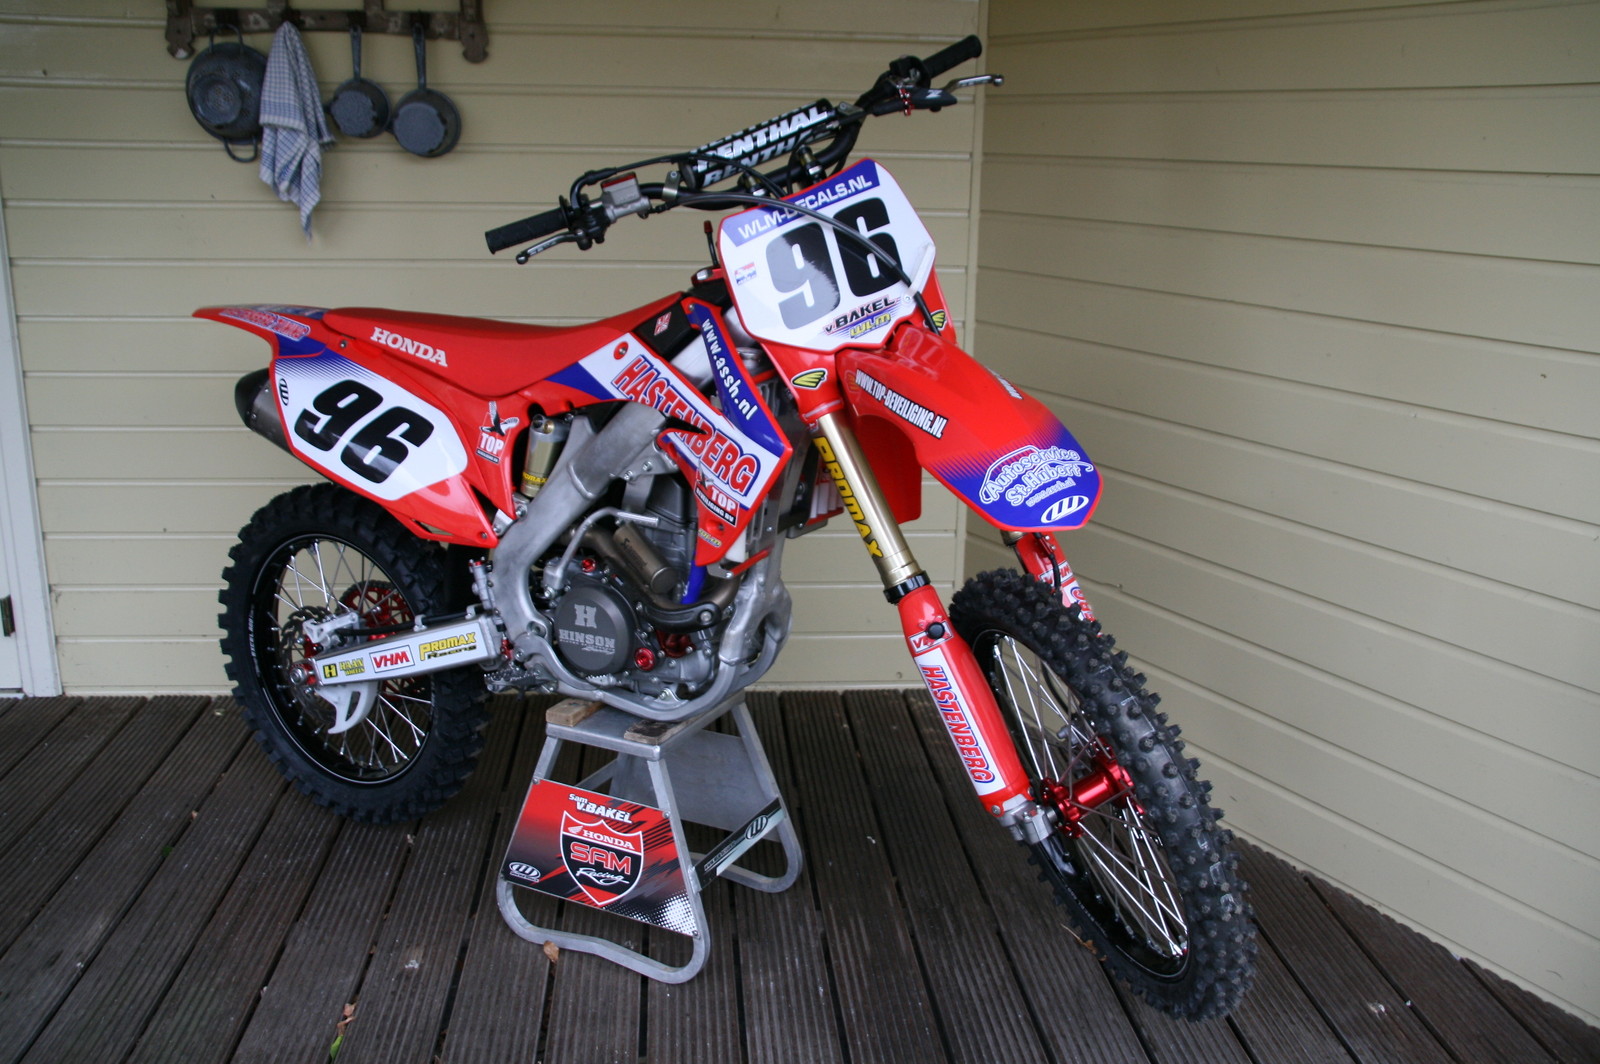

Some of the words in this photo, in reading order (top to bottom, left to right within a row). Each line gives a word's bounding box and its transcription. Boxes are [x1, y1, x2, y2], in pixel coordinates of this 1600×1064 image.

[738, 174, 872, 240] WLM-DECALS.NL
[765, 197, 901, 330] 96
[370, 327, 448, 368] HONDA
[702, 318, 758, 420] www.assh.nl
[294, 379, 435, 484] 96
[611, 354, 761, 497] HASTENBERG
[480, 432, 505, 455] TOP
[984, 445, 1081, 502] Autoservice
[711, 486, 737, 513] TOP
[812, 436, 884, 559] PROMAX
[574, 604, 597, 629] H
[419, 632, 477, 662] PROMAX
[558, 628, 616, 649] HINSON
[323, 664, 338, 678] H
[373, 651, 410, 668] VHM
[919, 664, 995, 783] HASTENBERG
[575, 801, 633, 824] V.BAKEL
[582, 829, 635, 850] HONDA
[570, 841, 632, 876] SAM
[575, 867, 630, 886] Racing
